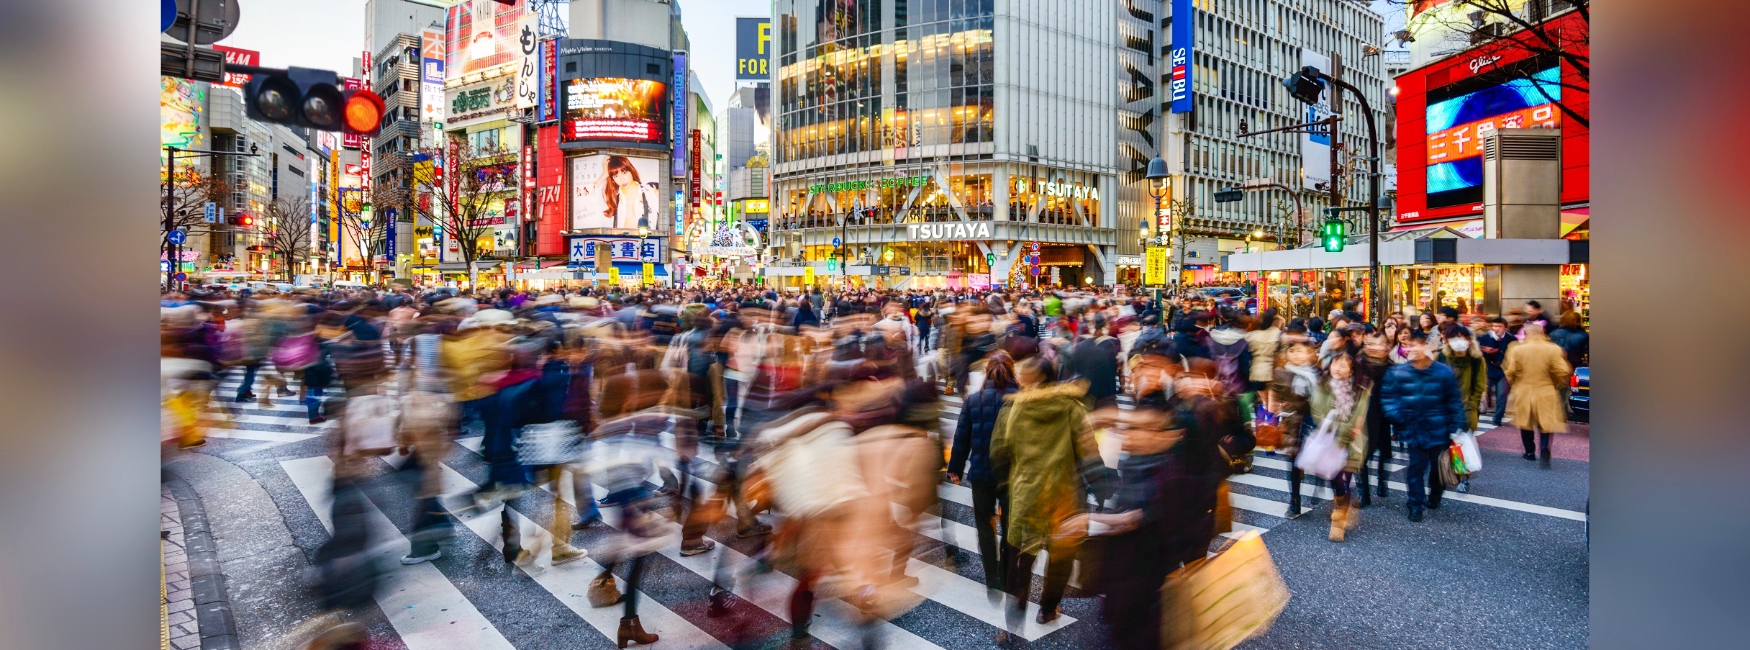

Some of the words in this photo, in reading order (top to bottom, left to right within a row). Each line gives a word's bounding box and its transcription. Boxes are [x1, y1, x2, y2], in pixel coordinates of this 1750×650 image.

[560, 47, 577, 55] Mighty
[576, 46, 593, 54] Vision
[1172, 47, 1186, 102] SEIBU
[693, 177, 701, 204] 三千里
[880, 175, 928, 189] COFFEE
[1038, 181, 1099, 201] TSUTAYA
[909, 222, 991, 240] TSUTAYA
